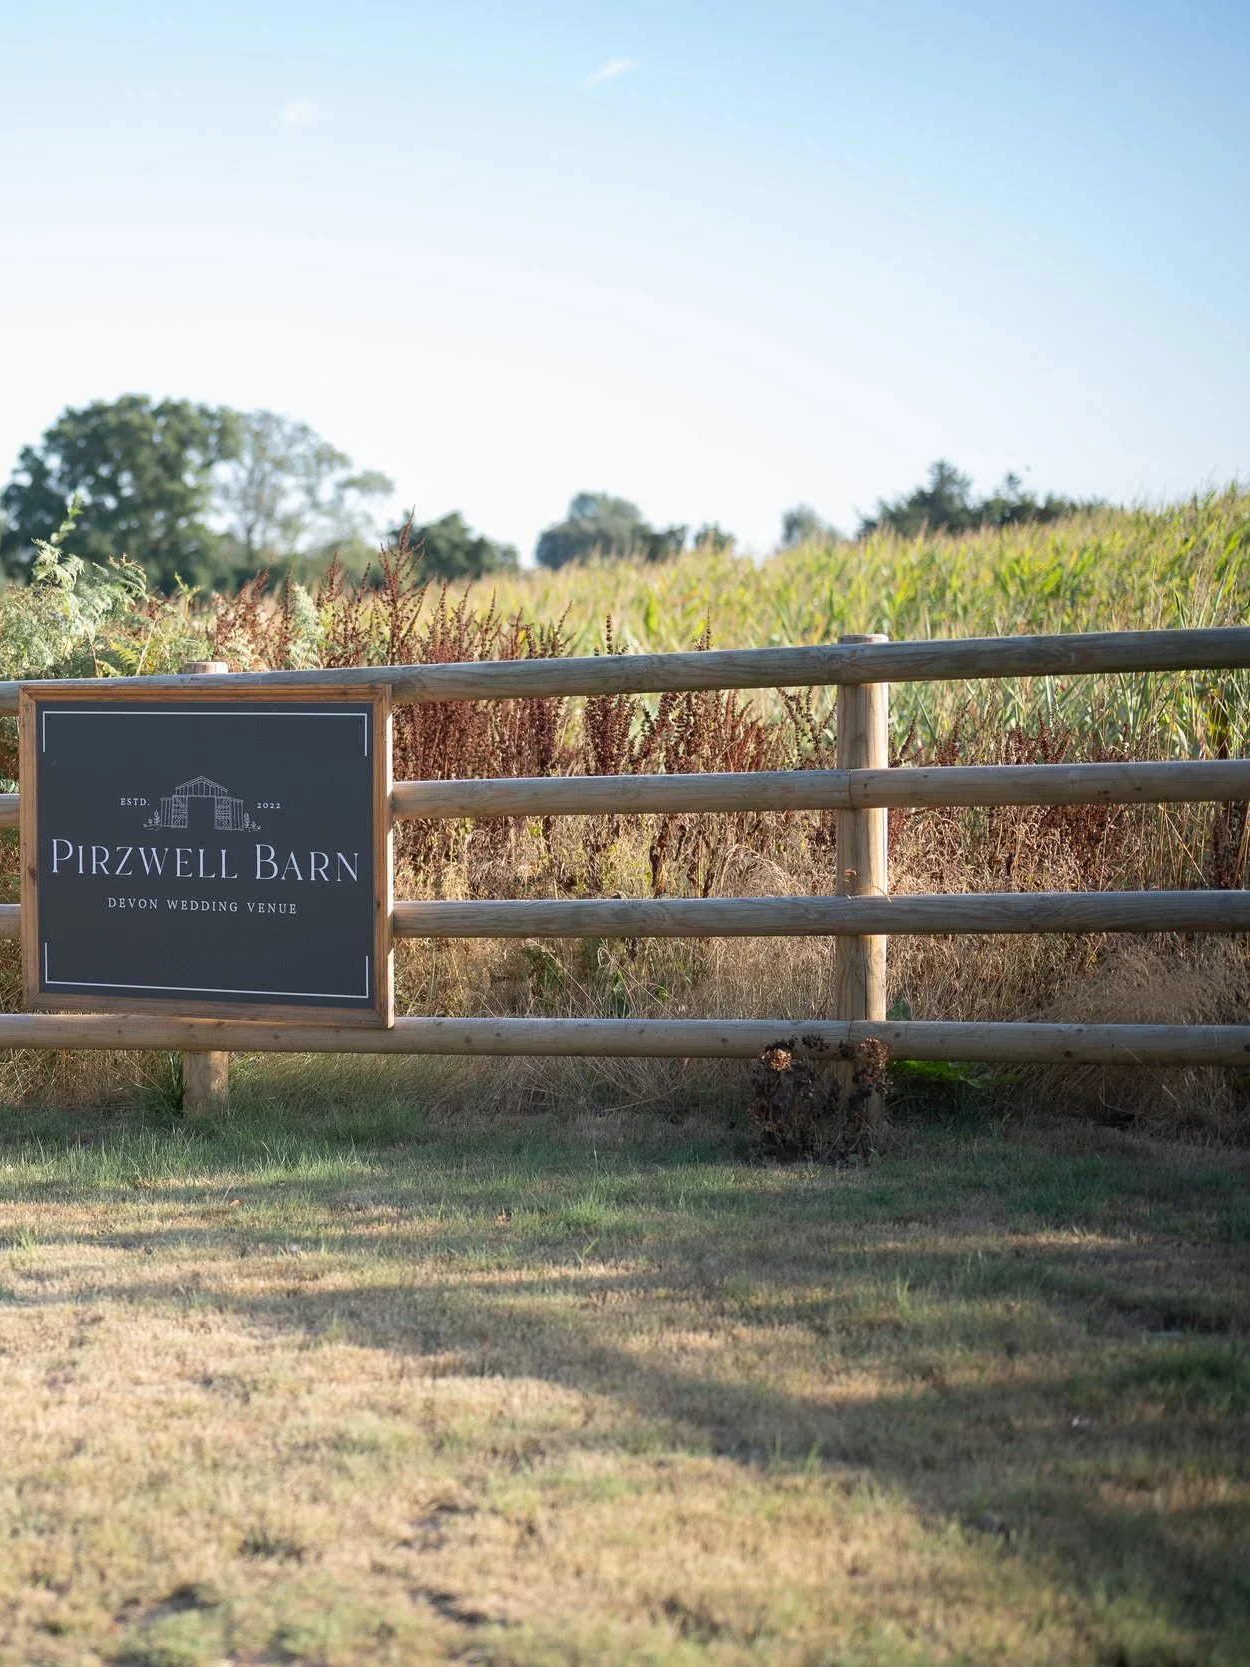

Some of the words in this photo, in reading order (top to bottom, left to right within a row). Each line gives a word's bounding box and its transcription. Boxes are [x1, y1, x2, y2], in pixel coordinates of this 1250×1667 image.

[120, 797, 151, 807] ESTD.
[256, 802, 281, 810] 2022
[51, 838, 239, 879] PIRZWELL
[255, 843, 359, 882] BARN
[107, 897, 158, 910] DEVON
[166, 899, 238, 913] WEDDING
[246, 902, 297, 915] VENUE
